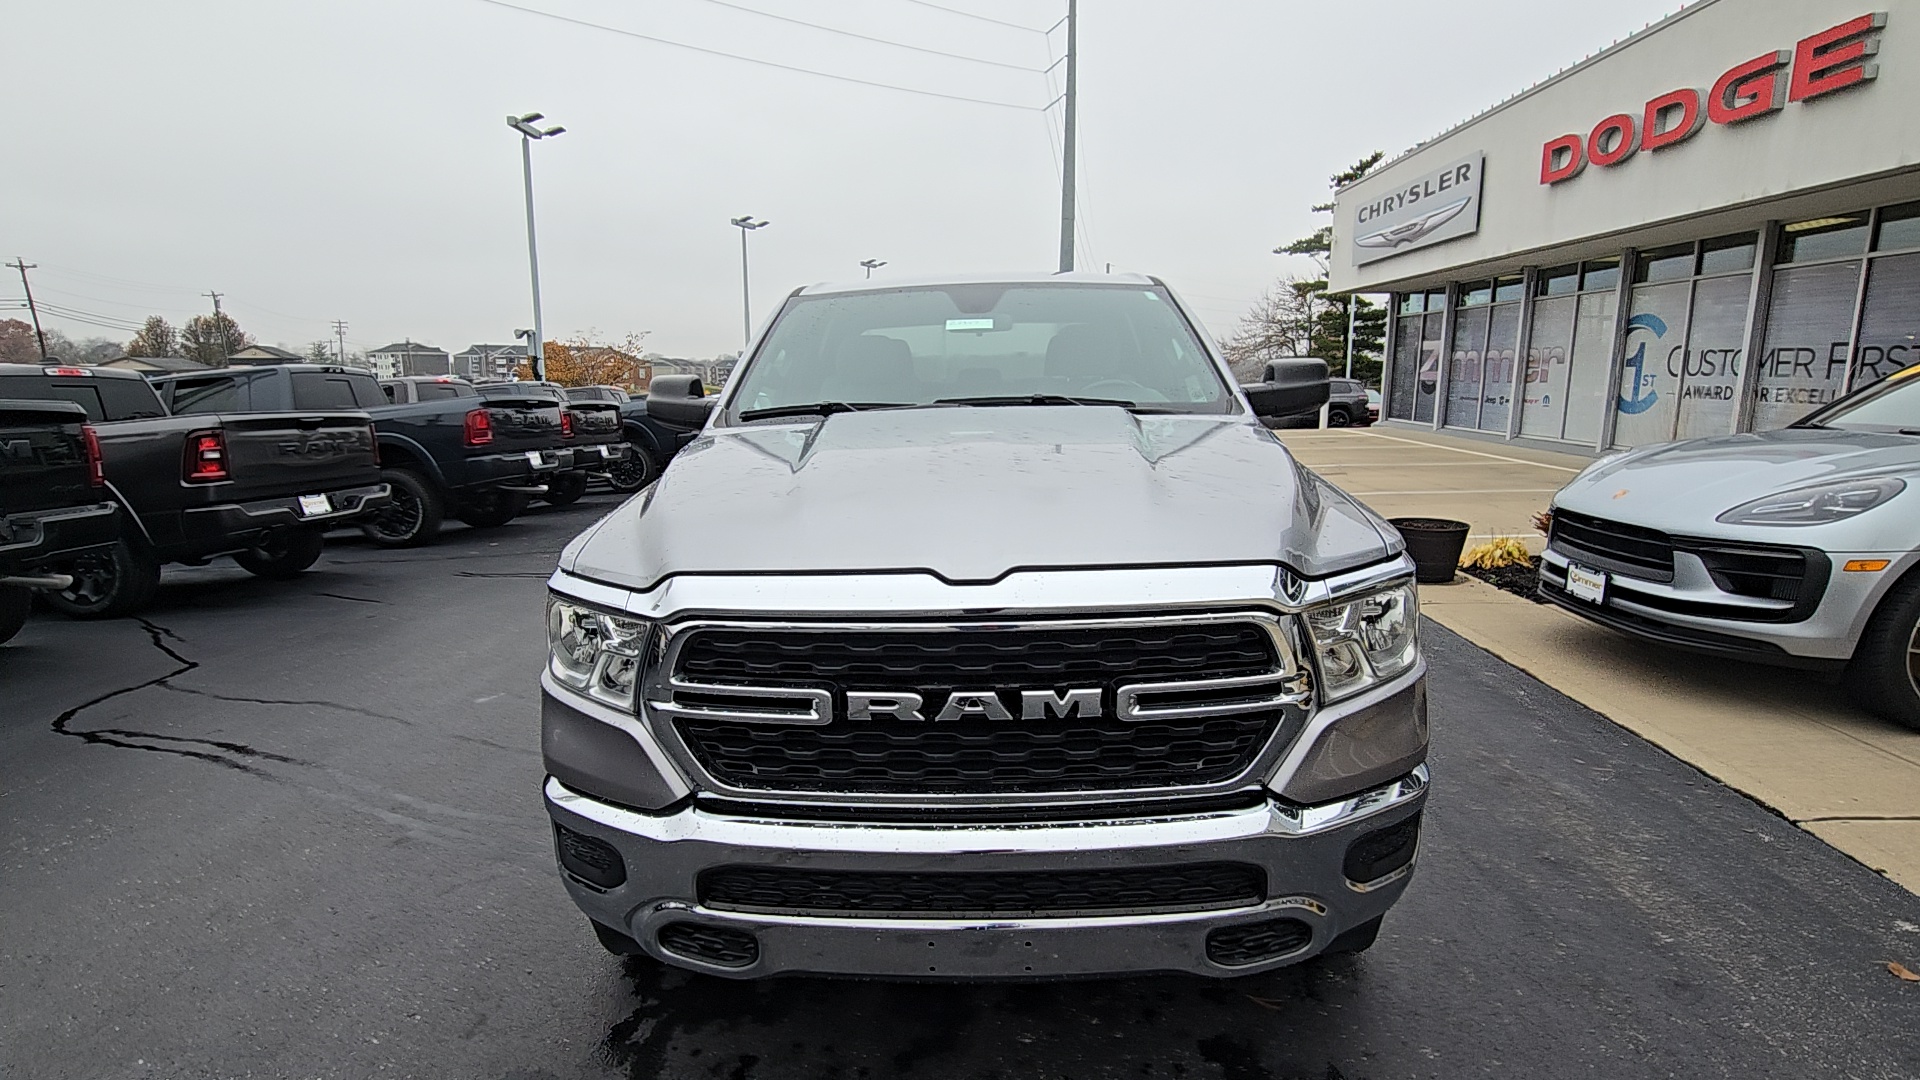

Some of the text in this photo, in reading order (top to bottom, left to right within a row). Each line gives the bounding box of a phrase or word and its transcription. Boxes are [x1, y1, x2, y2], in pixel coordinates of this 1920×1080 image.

[1540, 12, 1882, 186] DODGE
[1358, 163, 1471, 223] CHRYSLER
[1419, 339, 1565, 384] Zmmer
[1683, 385, 1734, 401] AWARD
[846, 688, 1103, 721] RAM
